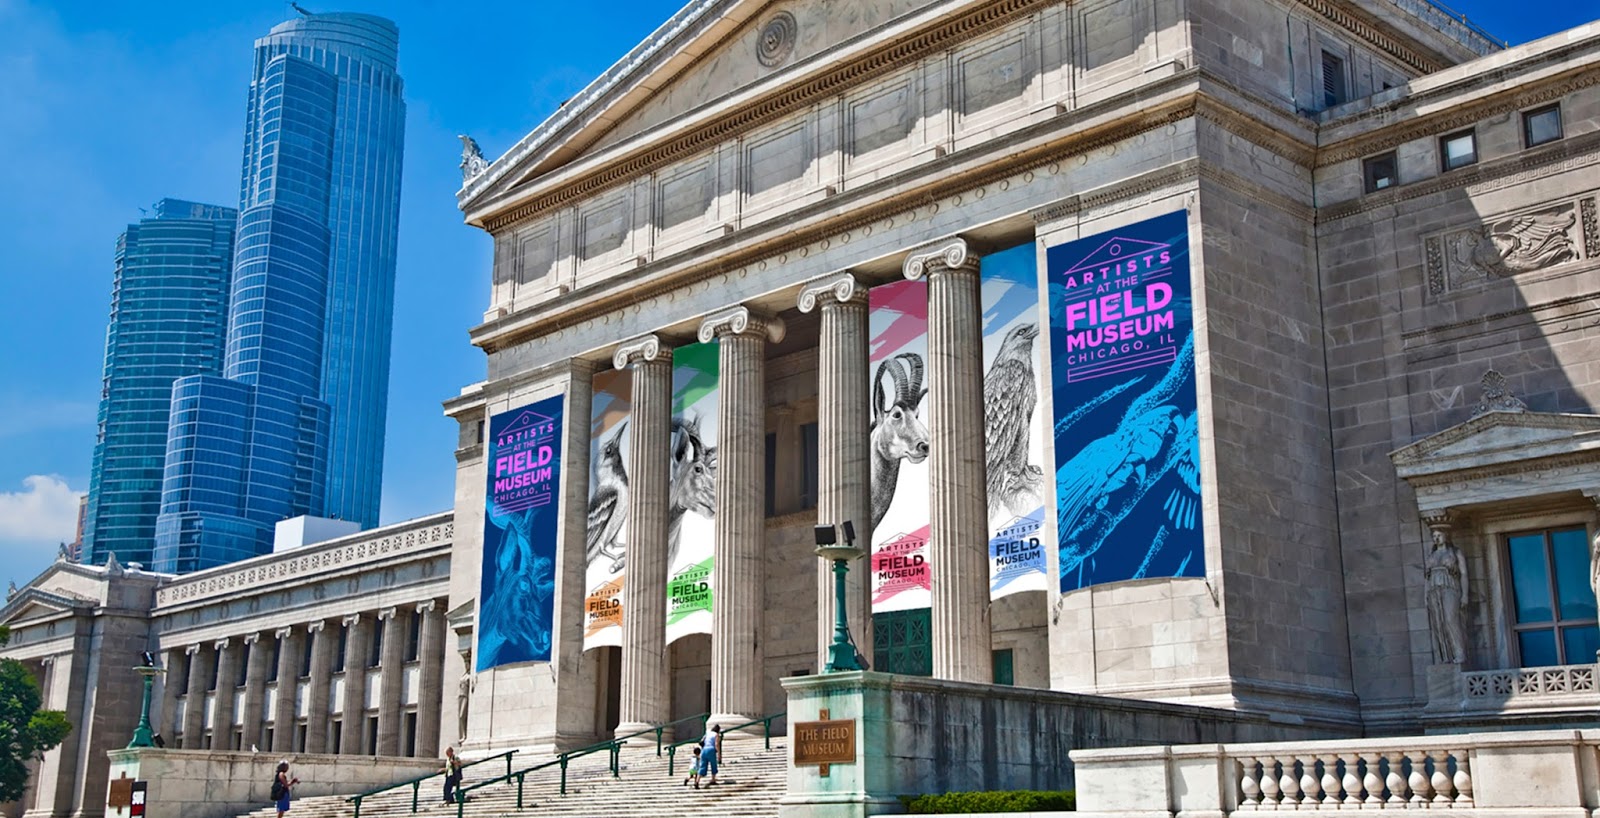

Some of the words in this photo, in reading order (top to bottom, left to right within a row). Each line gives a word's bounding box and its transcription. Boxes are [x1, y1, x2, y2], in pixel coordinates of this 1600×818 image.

[1065, 251, 1171, 290] ARTISTS
[1096, 282, 1111, 294] AT
[1114, 275, 1139, 289] THE
[1066, 282, 1173, 331] FIELD
[1067, 310, 1175, 353] MUSEUM
[1067, 340, 1150, 365] CHICAGO,
[1160, 333, 1175, 345] IL
[497, 423, 554, 447] ARTISTS
[513, 443, 522, 452] AT
[523, 440, 536, 450] THE
[495, 445, 553, 479] FIELD
[494, 466, 552, 494] MUSEUM
[494, 487, 538, 503] CHICAGO,
[542, 483, 551, 491] IL
[996, 523, 1040, 537] ARTISTS
[878, 541, 924, 552] ARTISTS
[996, 537, 1040, 556] FIELD
[878, 554, 925, 570] FIELD
[996, 550, 1040, 566] MUSEUM
[673, 571, 709, 581] ARTISTS
[878, 567, 925, 580] MUSEUM
[590, 588, 620, 597] ARTISTS
[672, 582, 708, 597] FIELD
[589, 598, 620, 611] FIELD
[671, 593, 708, 605] MUSEUM
[589, 609, 620, 619] MUSEUM
[800, 728, 818, 741] THE
[822, 727, 849, 740] FIELD
[802, 742, 845, 755] MUSEUM
